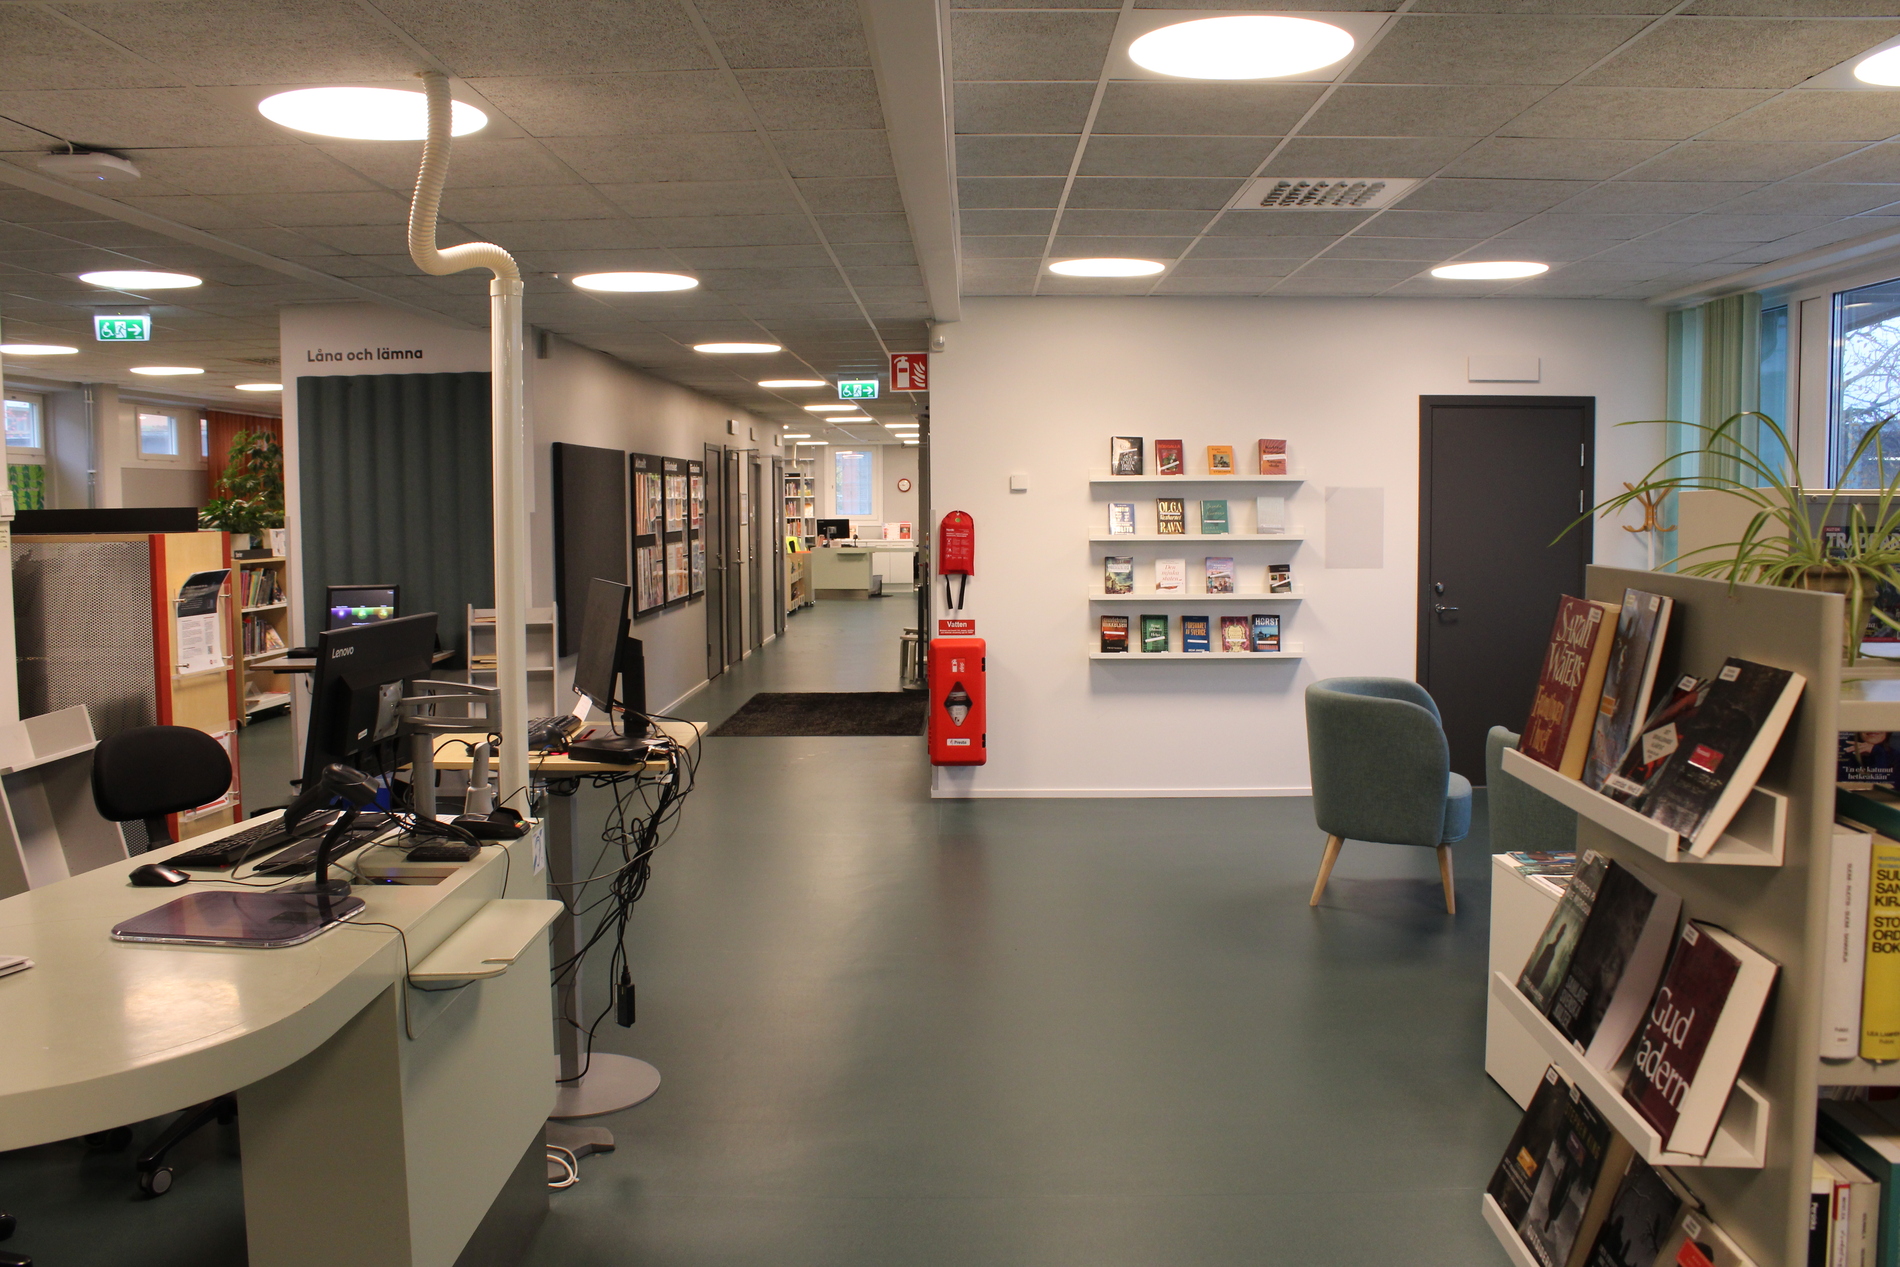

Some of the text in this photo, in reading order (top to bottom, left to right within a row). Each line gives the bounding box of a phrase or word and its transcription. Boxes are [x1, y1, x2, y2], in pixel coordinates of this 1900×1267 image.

[307, 347, 423, 362] Låna och lämna
[1160, 502, 1182, 512] OLGA
[1160, 522, 1182, 532] RAVN
[332, 646, 354, 659] Lenovo
[1874, 895, 1900, 907] KIR
[1652, 986, 1695, 1050] Gud
[1636, 1024, 1691, 1114] adern
